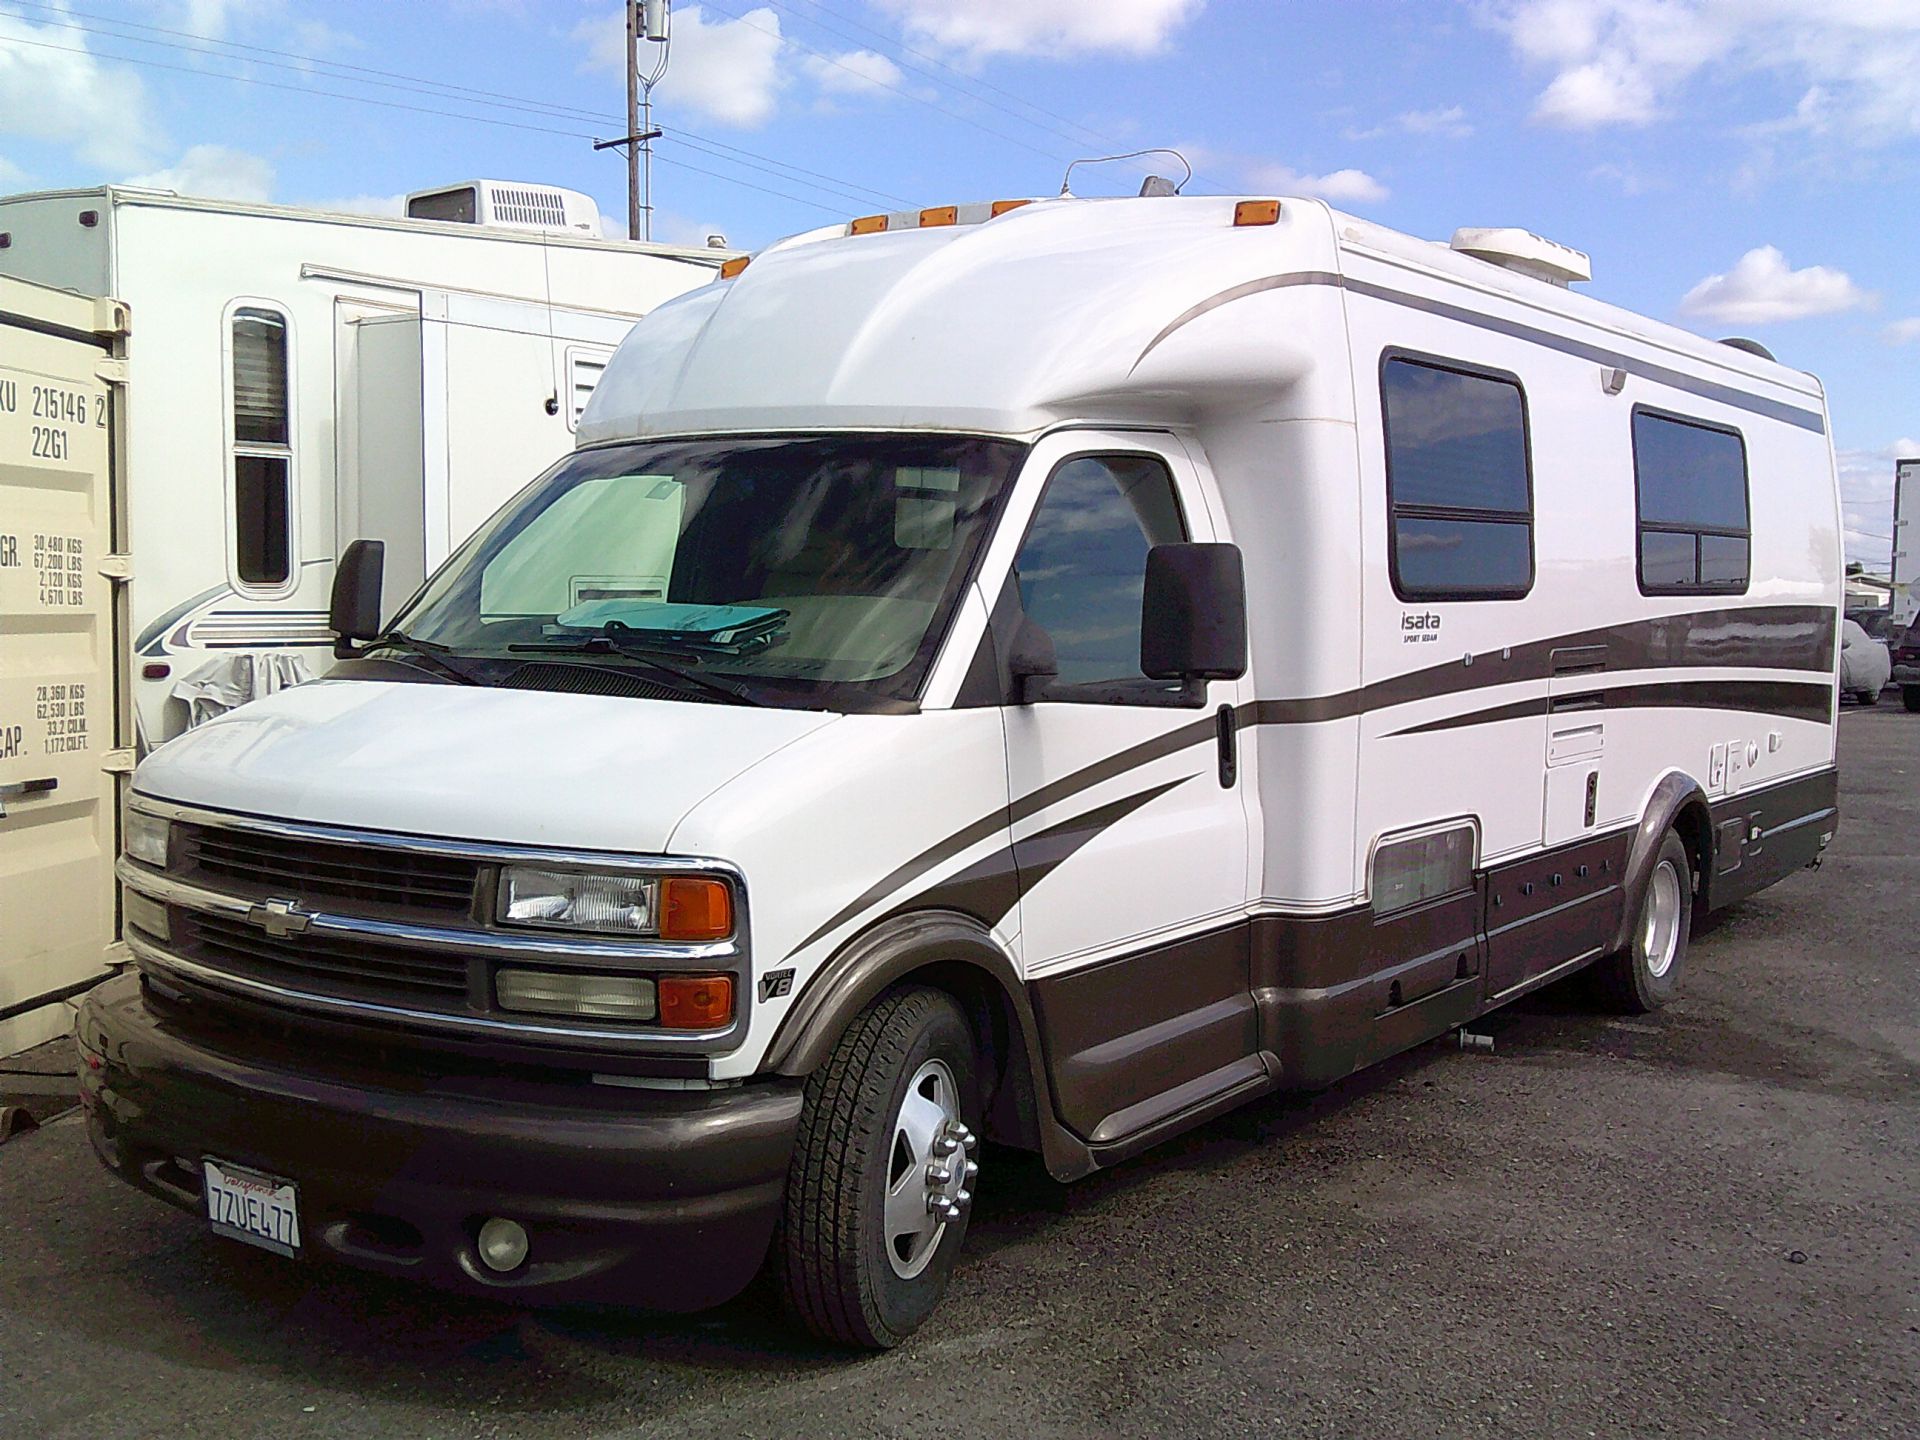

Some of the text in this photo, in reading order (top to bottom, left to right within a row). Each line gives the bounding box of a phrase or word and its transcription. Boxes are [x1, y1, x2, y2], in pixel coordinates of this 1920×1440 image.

[32, 386, 86, 424] 215146
[96, 397, 106, 427] 2
[32, 426, 68, 460] 22G1
[67, 538, 82, 554] KGS
[67, 556, 82, 571] LBS
[67, 572, 82, 588] KGS
[67, 590, 83, 606] LBS
[1401, 611, 1441, 630] isata
[1403, 633, 1438, 643] SPORT SEDAN
[69, 684, 85, 700] KGS
[69, 701, 85, 717] LBS
[759, 978, 792, 1002] V8
[210, 1186, 294, 1245] 7ZUE477
